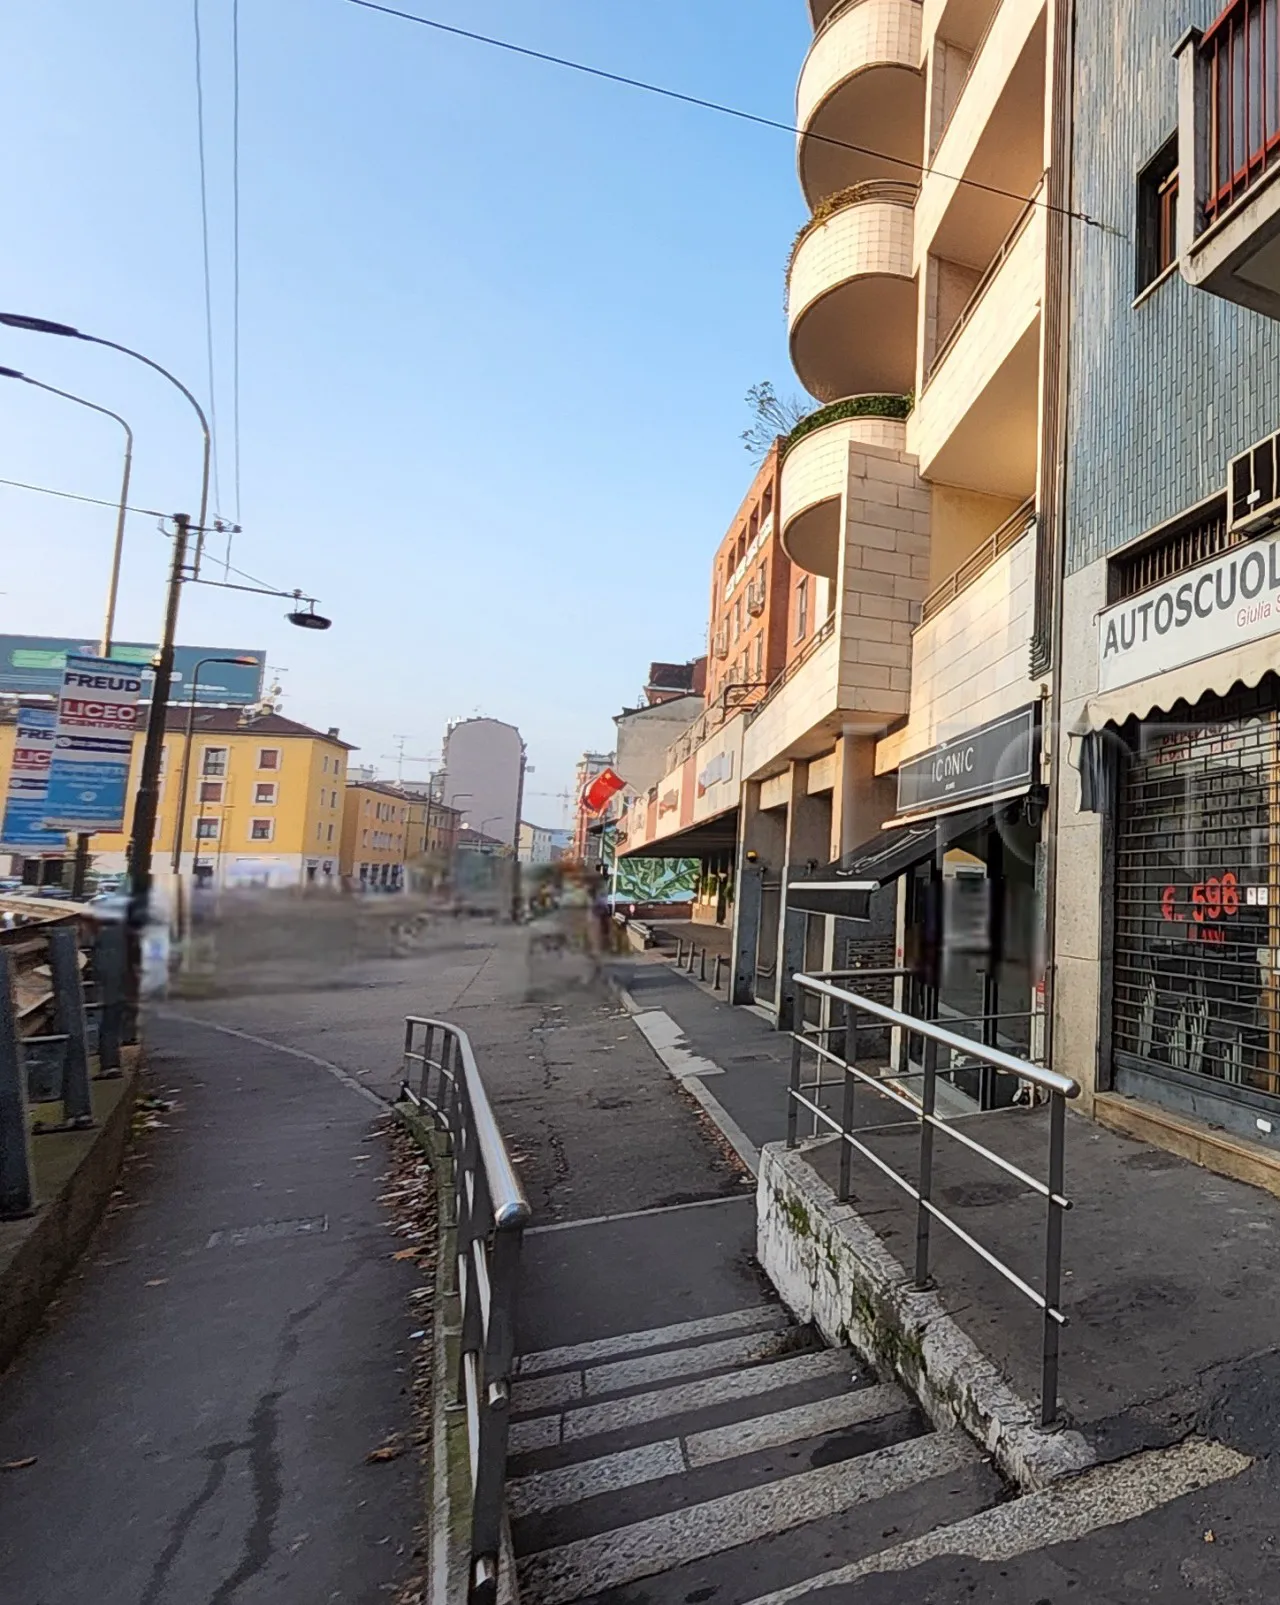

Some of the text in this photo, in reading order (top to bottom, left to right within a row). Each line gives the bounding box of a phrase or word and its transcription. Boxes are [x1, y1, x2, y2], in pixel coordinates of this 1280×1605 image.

[1236, 597, 1271, 628] Giulia
[64, 672, 141, 692] FREUD
[63, 701, 136, 720] LICEO
[16, 727, 54, 740] FRE
[931, 746, 975, 783] ICONIC
[1191, 871, 1239, 922] 598
